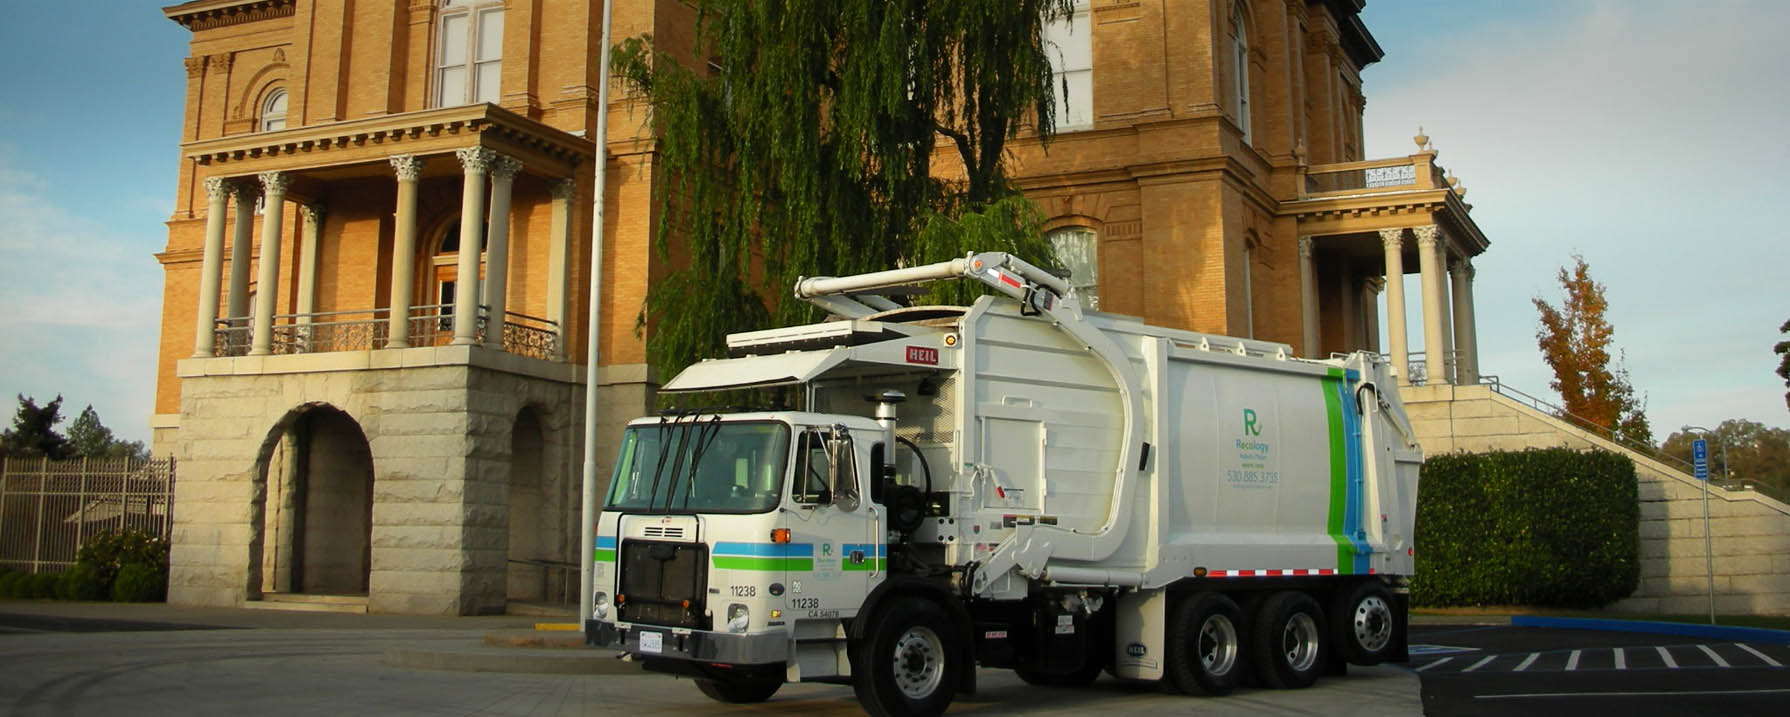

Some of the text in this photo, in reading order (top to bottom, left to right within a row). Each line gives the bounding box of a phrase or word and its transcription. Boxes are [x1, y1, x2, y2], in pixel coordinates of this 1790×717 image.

[910, 348, 937, 362] HEIL
[1235, 439, 1269, 454] Recology
[730, 585, 756, 597] 11238
[792, 598, 819, 609] 11238
[808, 610, 818, 618] CA
